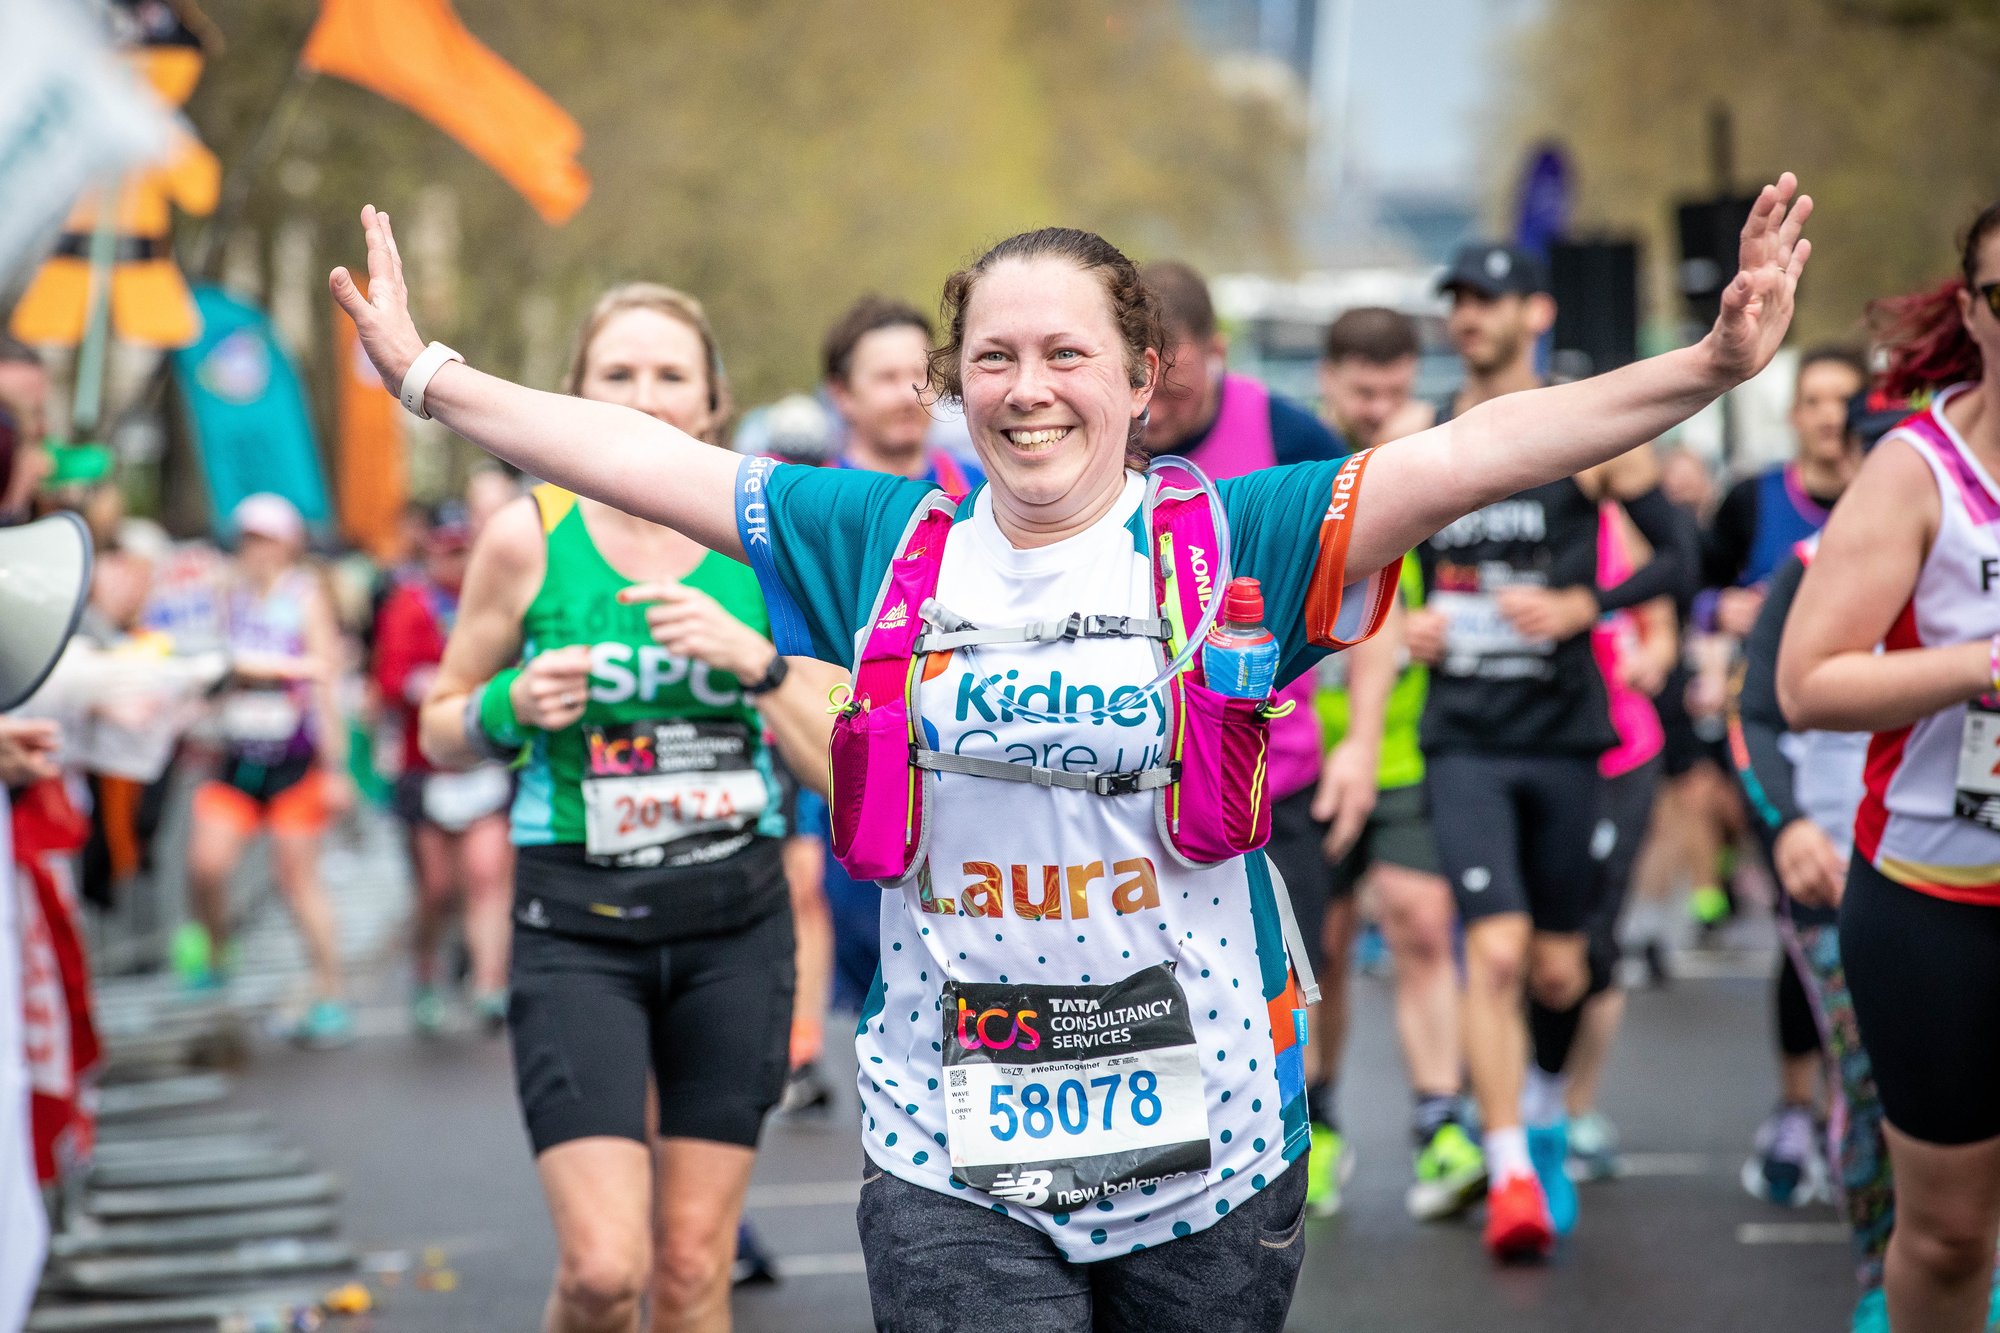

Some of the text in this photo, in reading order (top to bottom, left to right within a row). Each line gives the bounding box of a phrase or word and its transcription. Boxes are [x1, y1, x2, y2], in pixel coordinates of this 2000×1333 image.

[744, 503, 767, 545] UK
[590, 734, 655, 776] tcs
[917, 856, 1161, 921] Laura
[1049, 998, 1100, 1013] TATA
[1050, 999, 1173, 1032] CONSULTANCY
[957, 998, 1041, 1051] tcs
[1052, 1029, 1132, 1050] SERVICES
[1031, 1062, 1100, 1074] #WeRunTogether
[951, 1107, 972, 1115] LORRY
[989, 1070, 1162, 1142] 58078
[1057, 1186, 1100, 1205] new
